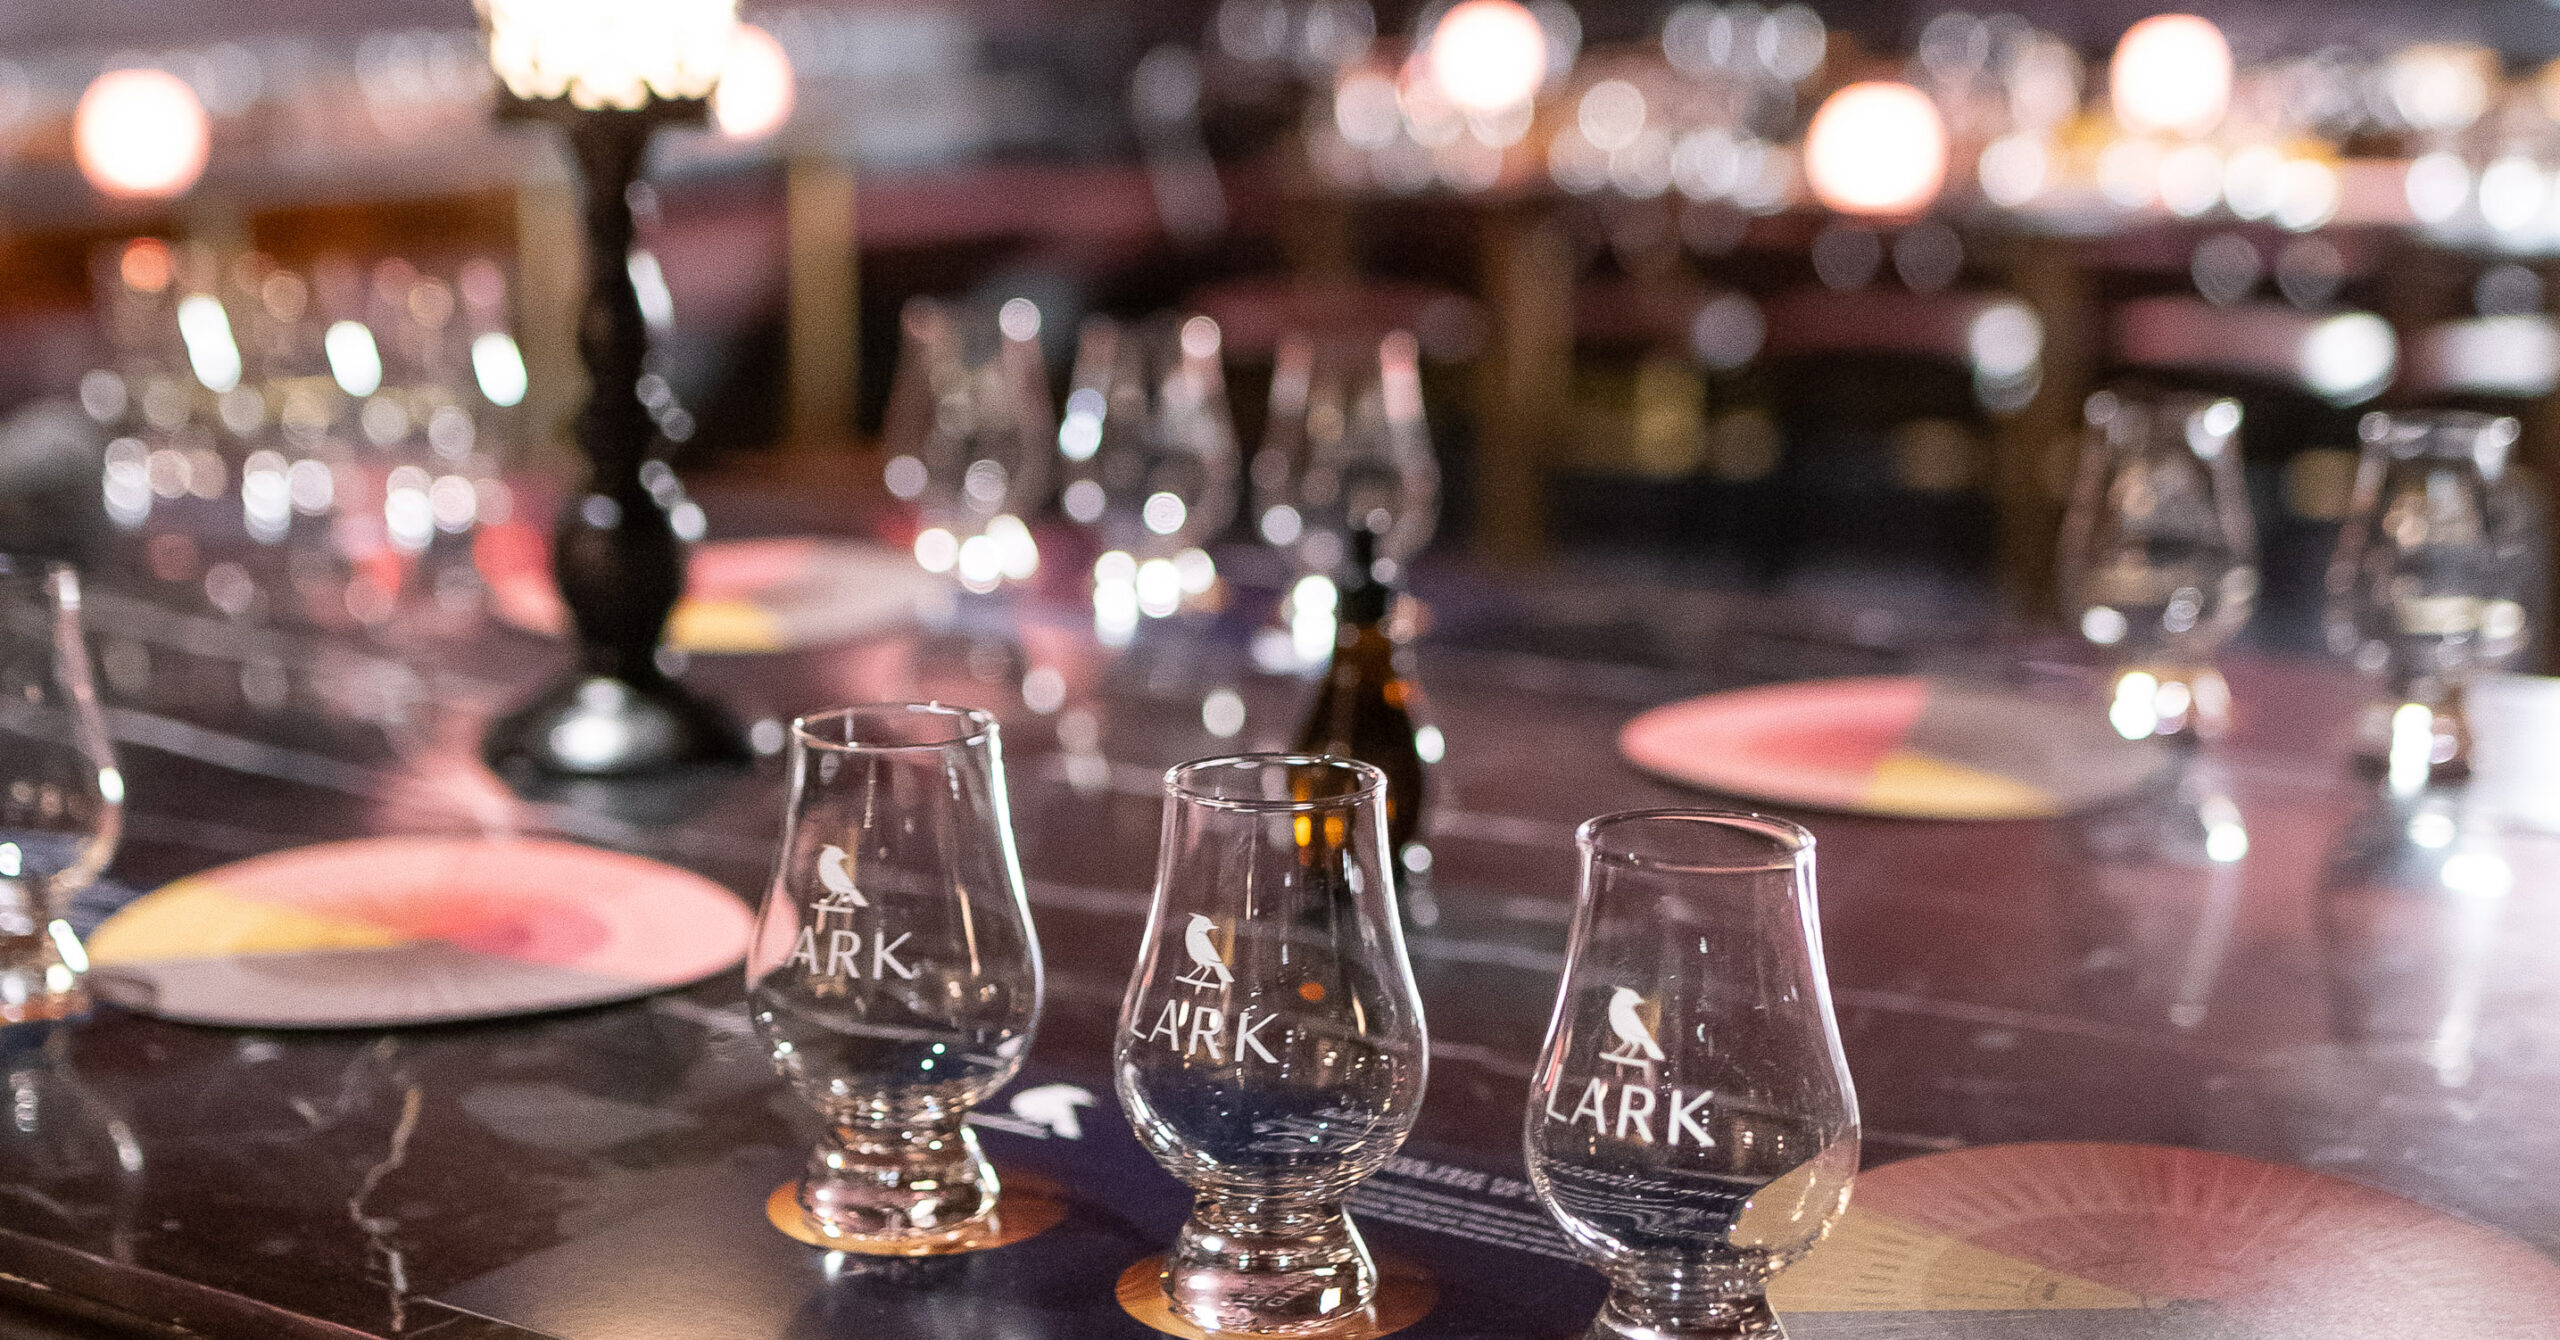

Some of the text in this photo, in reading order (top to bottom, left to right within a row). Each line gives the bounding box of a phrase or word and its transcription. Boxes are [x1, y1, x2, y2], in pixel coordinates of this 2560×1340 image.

[776, 924, 915, 980] ARK
[1129, 988, 1280, 1064] LARK
[1545, 1064, 1716, 1147] LARK
